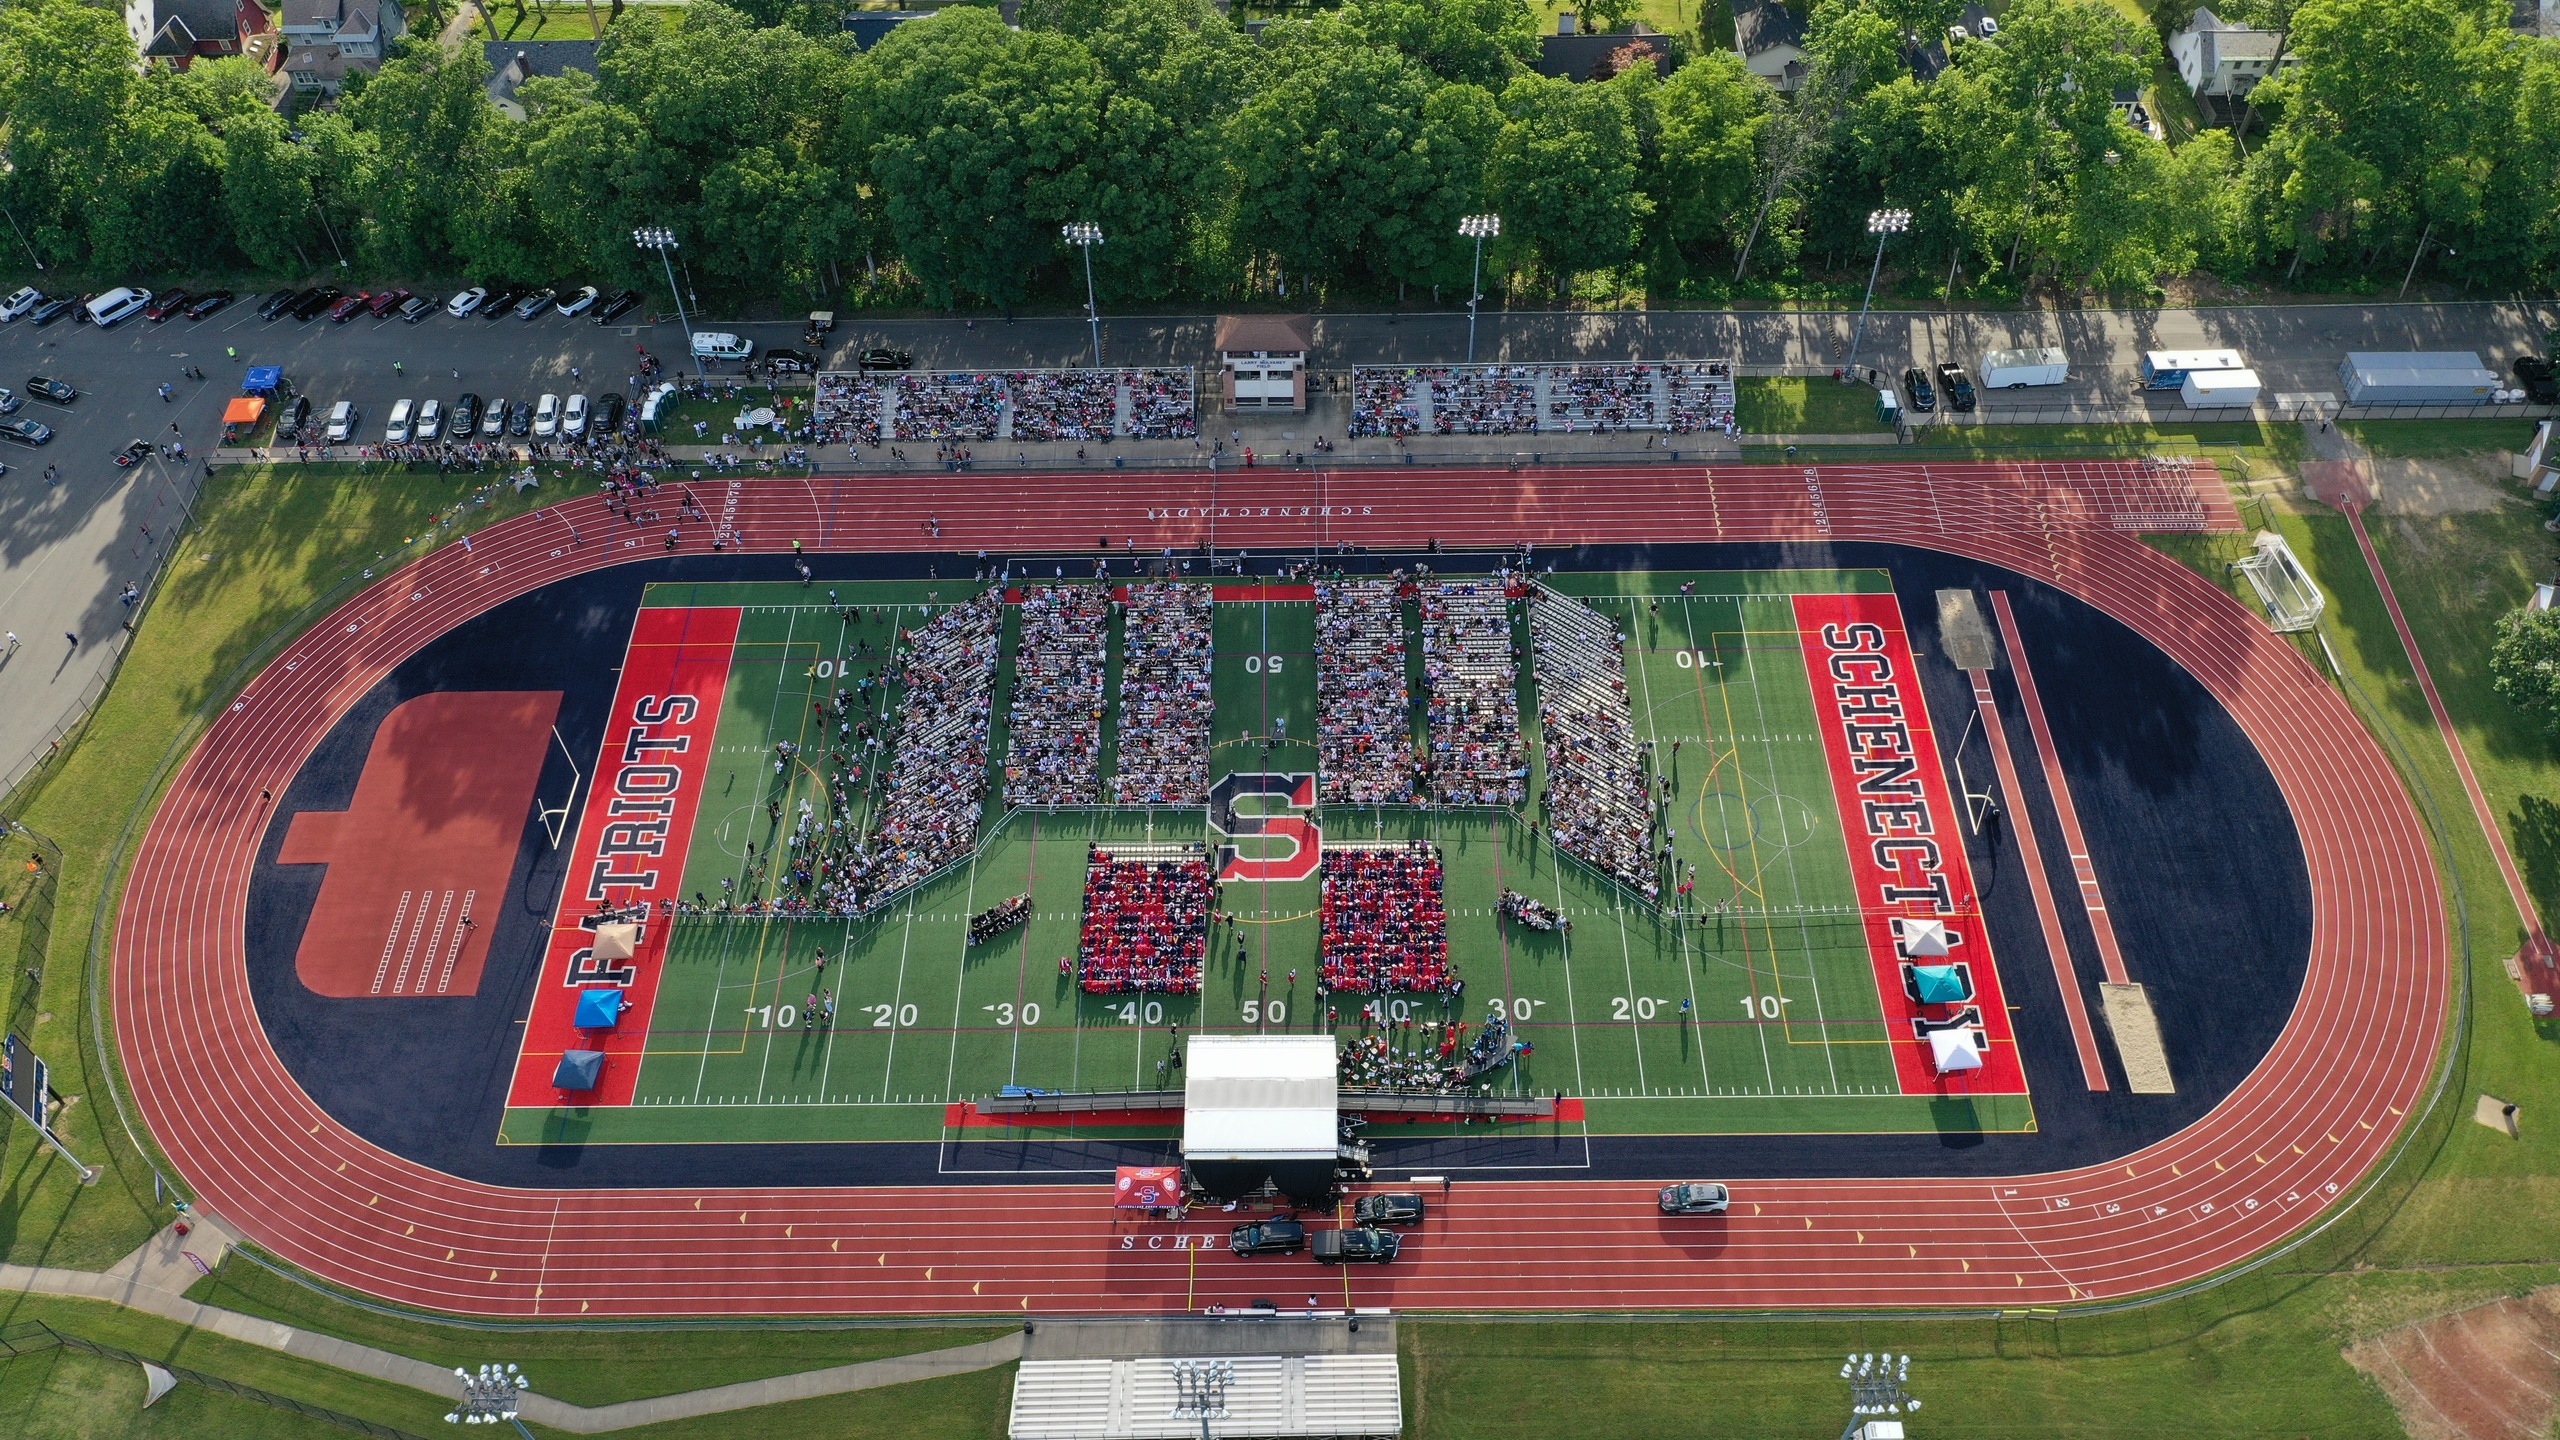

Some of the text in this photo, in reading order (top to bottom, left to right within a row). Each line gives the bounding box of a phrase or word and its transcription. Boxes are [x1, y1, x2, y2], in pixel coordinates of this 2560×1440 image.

[1159, 506, 1372, 517] SCHENECTADY
[411, 593, 422, 601] 5
[286, 662, 297, 670] 7
[1245, 656, 1283, 673] 50
[1676, 651, 1710, 668] 10
[817, 661, 849, 678] 10
[233, 703, 243, 711] 8
[1206, 772, 1322, 882] S
[873, 1003, 918, 1027] 20
[996, 1002, 1040, 1026] 30
[1119, 1001, 1163, 1025] 40
[1242, 1000, 1286, 1024] 50
[1367, 999, 1408, 1022] 40
[1488, 998, 1532, 1020] 30
[1611, 997, 1656, 1020] 20
[1740, 995, 1780, 1019] 10
[758, 1004, 796, 1028] 10
[1140, 1186, 1155, 1203] S
[2325, 1182, 2338, 1194] 8
[2055, 1198, 2070, 1207] 2
[2245, 1199, 2259, 1209] 6
[2287, 1192, 2300, 1202] 7
[2106, 1203, 2120, 1213] 3
[2154, 1206, 2167, 1216] 4
[2200, 1203, 2214, 1213] 5
[1121, 1235, 1232, 1249] SCHE
